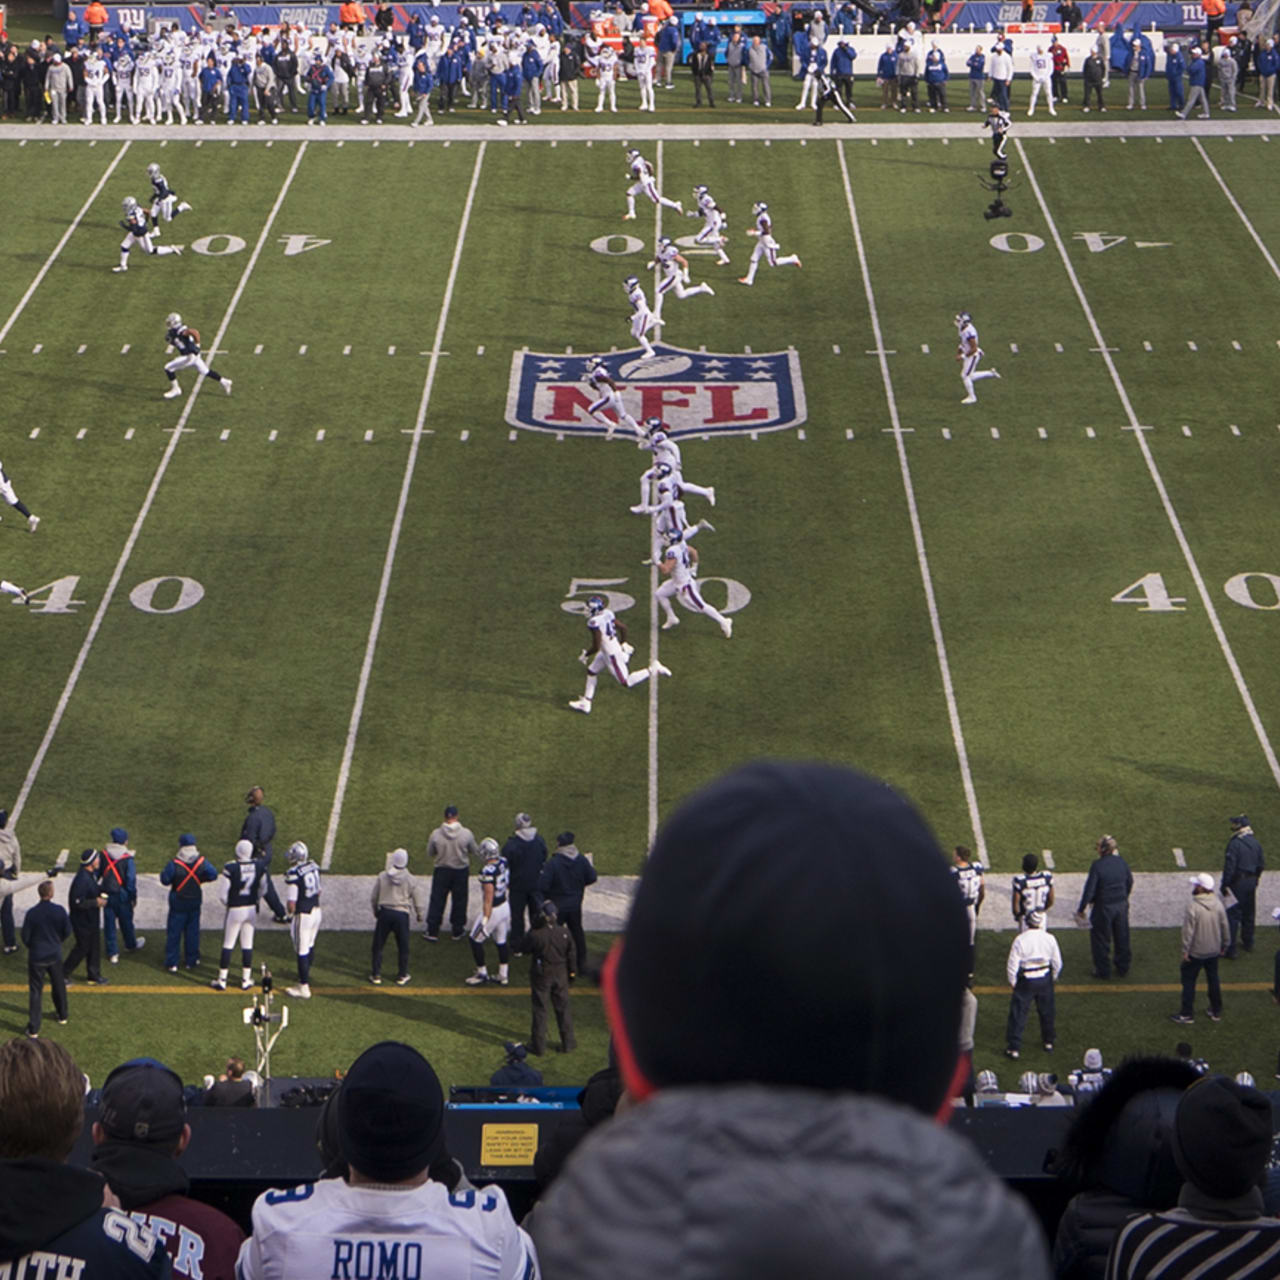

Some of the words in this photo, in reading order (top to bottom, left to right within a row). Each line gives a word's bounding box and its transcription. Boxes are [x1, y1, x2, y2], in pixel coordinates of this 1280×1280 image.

[279, 7, 328, 25] GIANTS
[999, 4, 1049, 22] GIATS
[544, 385, 769, 430] NFL
[11, 576, 205, 613] 40
[560, 577, 751, 615] 50
[238, 871, 257, 896] 7
[331, 1239, 423, 1280] ROMO
